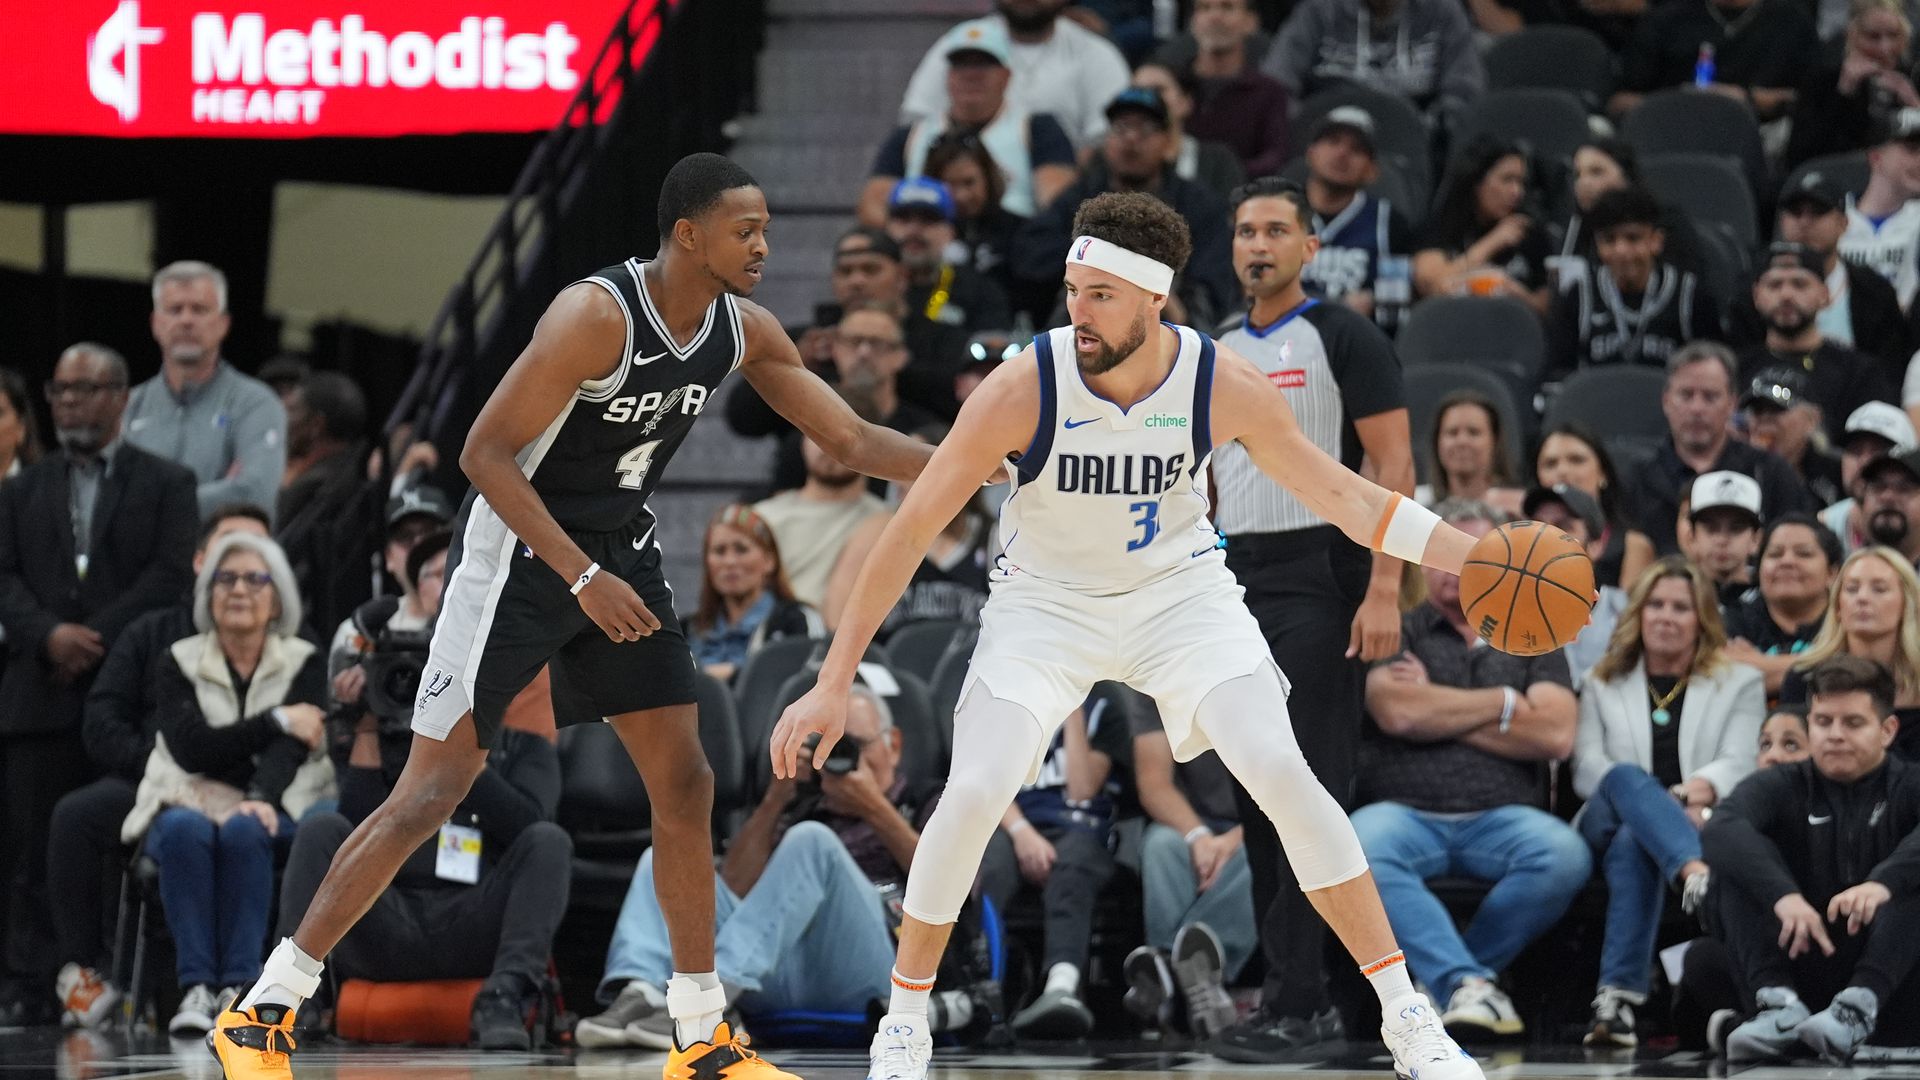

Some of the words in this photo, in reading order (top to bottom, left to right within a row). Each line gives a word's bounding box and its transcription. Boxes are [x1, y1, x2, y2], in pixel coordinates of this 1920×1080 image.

[191, 12, 579, 91] Methodist
[191, 89, 325, 124] HEART
[1144, 413, 1187, 428] chime
[615, 439, 663, 490] 4
[1056, 452, 1185, 495] DALLAS
[1126, 500, 1161, 553] 3
